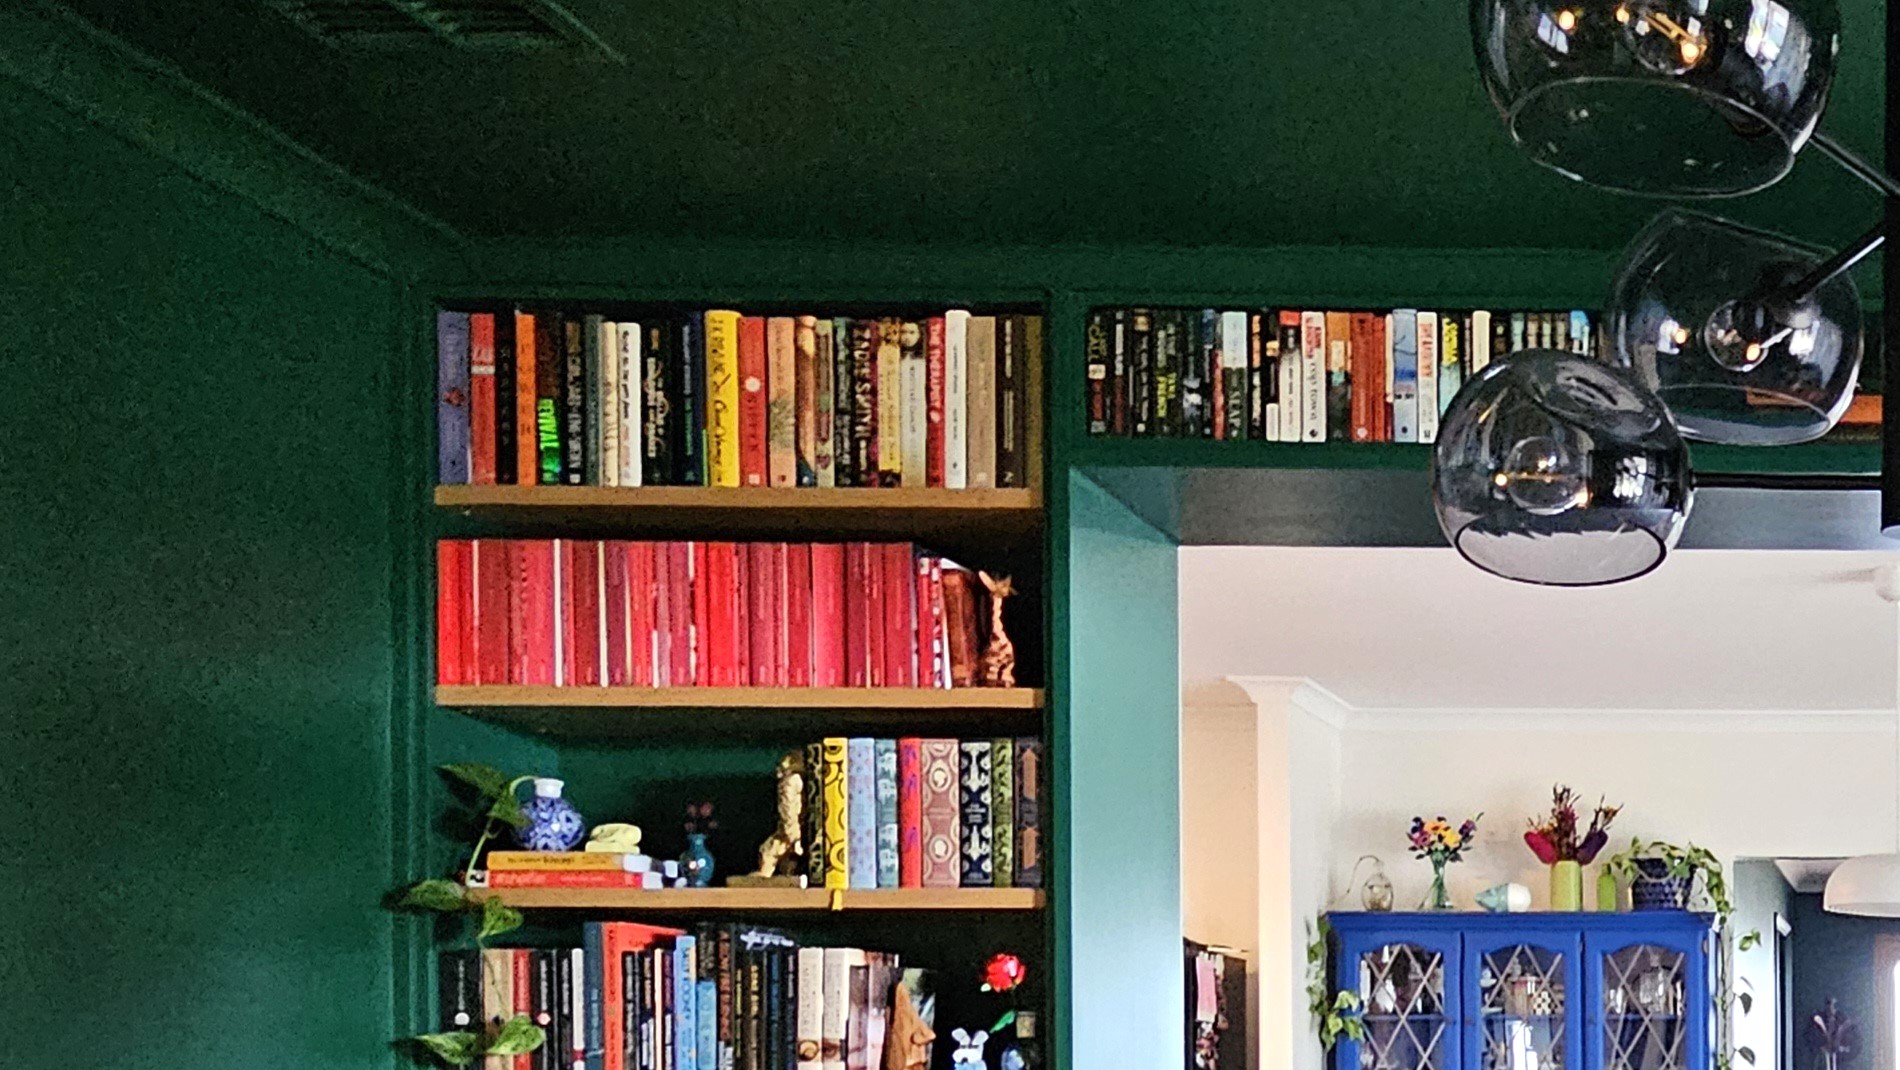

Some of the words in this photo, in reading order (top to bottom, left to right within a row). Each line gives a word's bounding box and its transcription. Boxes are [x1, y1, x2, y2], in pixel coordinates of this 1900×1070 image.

[853, 328, 872, 378] ZADIE
[929, 322, 941, 346] THE
[537, 399, 560, 450] REVIVAL
[854, 382, 872, 439] SMITH
[1229, 390, 1241, 428] SLAP
